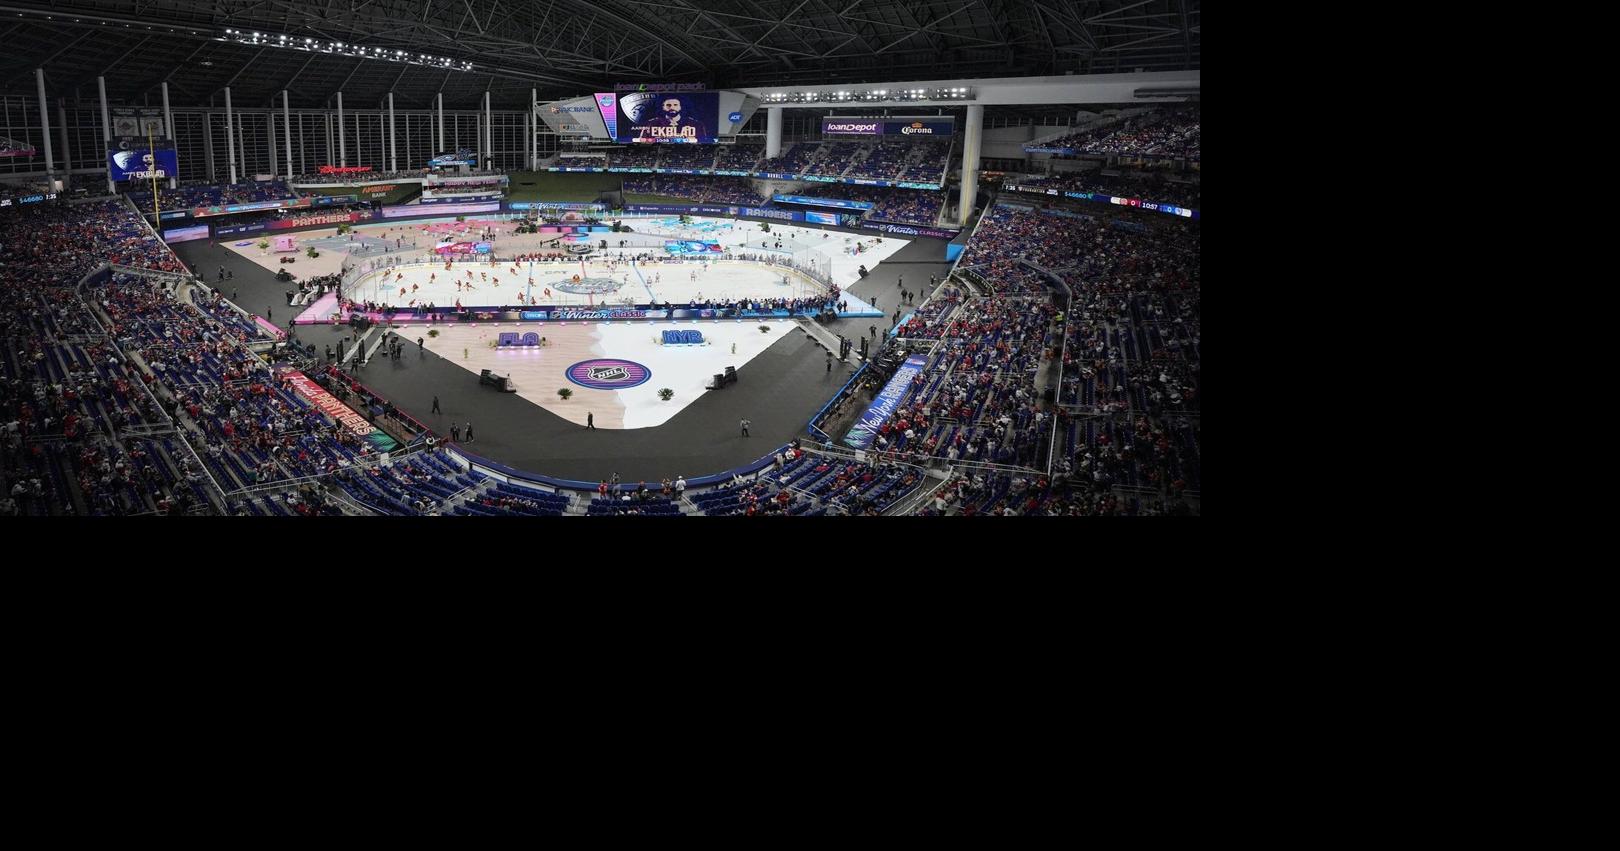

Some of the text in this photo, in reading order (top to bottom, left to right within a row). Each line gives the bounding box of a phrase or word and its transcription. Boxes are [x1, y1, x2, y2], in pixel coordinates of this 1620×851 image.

[651, 126, 696, 137] EKBLAD
[827, 122, 876, 132] loanDepot
[901, 126, 932, 135] Corona
[292, 214, 351, 227] PANTHERS
[746, 208, 793, 220] RANGERS
[886, 224, 918, 235] Winter
[919, 230, 945, 238] CLASSIC
[563, 310, 647, 319] Winter CLASSIC
[499, 332, 540, 346] FLA
[662, 330, 704, 344] NYR
[597, 368, 622, 379] NHL
[313, 392, 377, 435] PANTHERS
[869, 397, 896, 417] York
[860, 414, 884, 434] New
